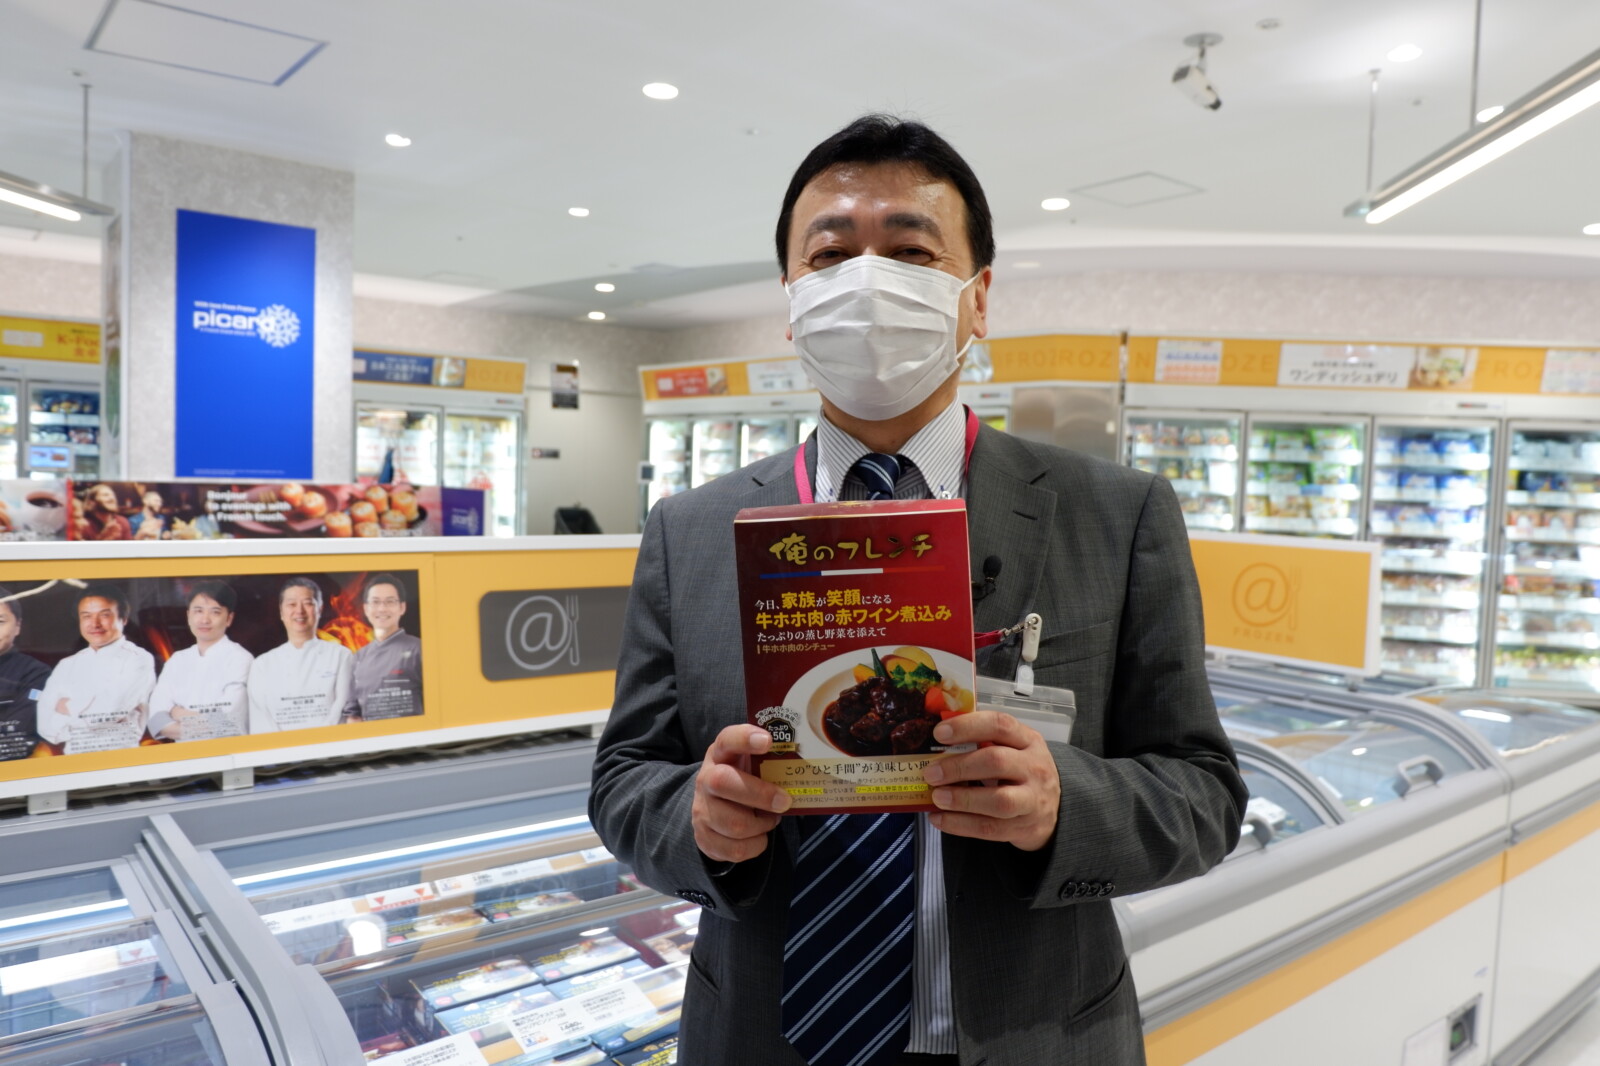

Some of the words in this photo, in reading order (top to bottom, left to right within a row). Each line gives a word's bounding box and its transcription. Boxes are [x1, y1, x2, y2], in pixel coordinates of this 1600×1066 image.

[193, 309, 275, 334] picard
[1290, 369, 1398, 384] ワンディッシュデリ
[217, 512, 253, 521] French
[769, 532, 933, 565] 俺のフレンチ
[754, 588, 892, 610] 今日、家族が笑顔になる
[755, 605, 952, 629] 牛ホホ肉の赤ワイン煮込み
[757, 626, 887, 642] たっぷりの蒸し野菜を添えて
[1233, 626, 1295, 643] FROZEN
[771, 731, 790, 742] 50g
